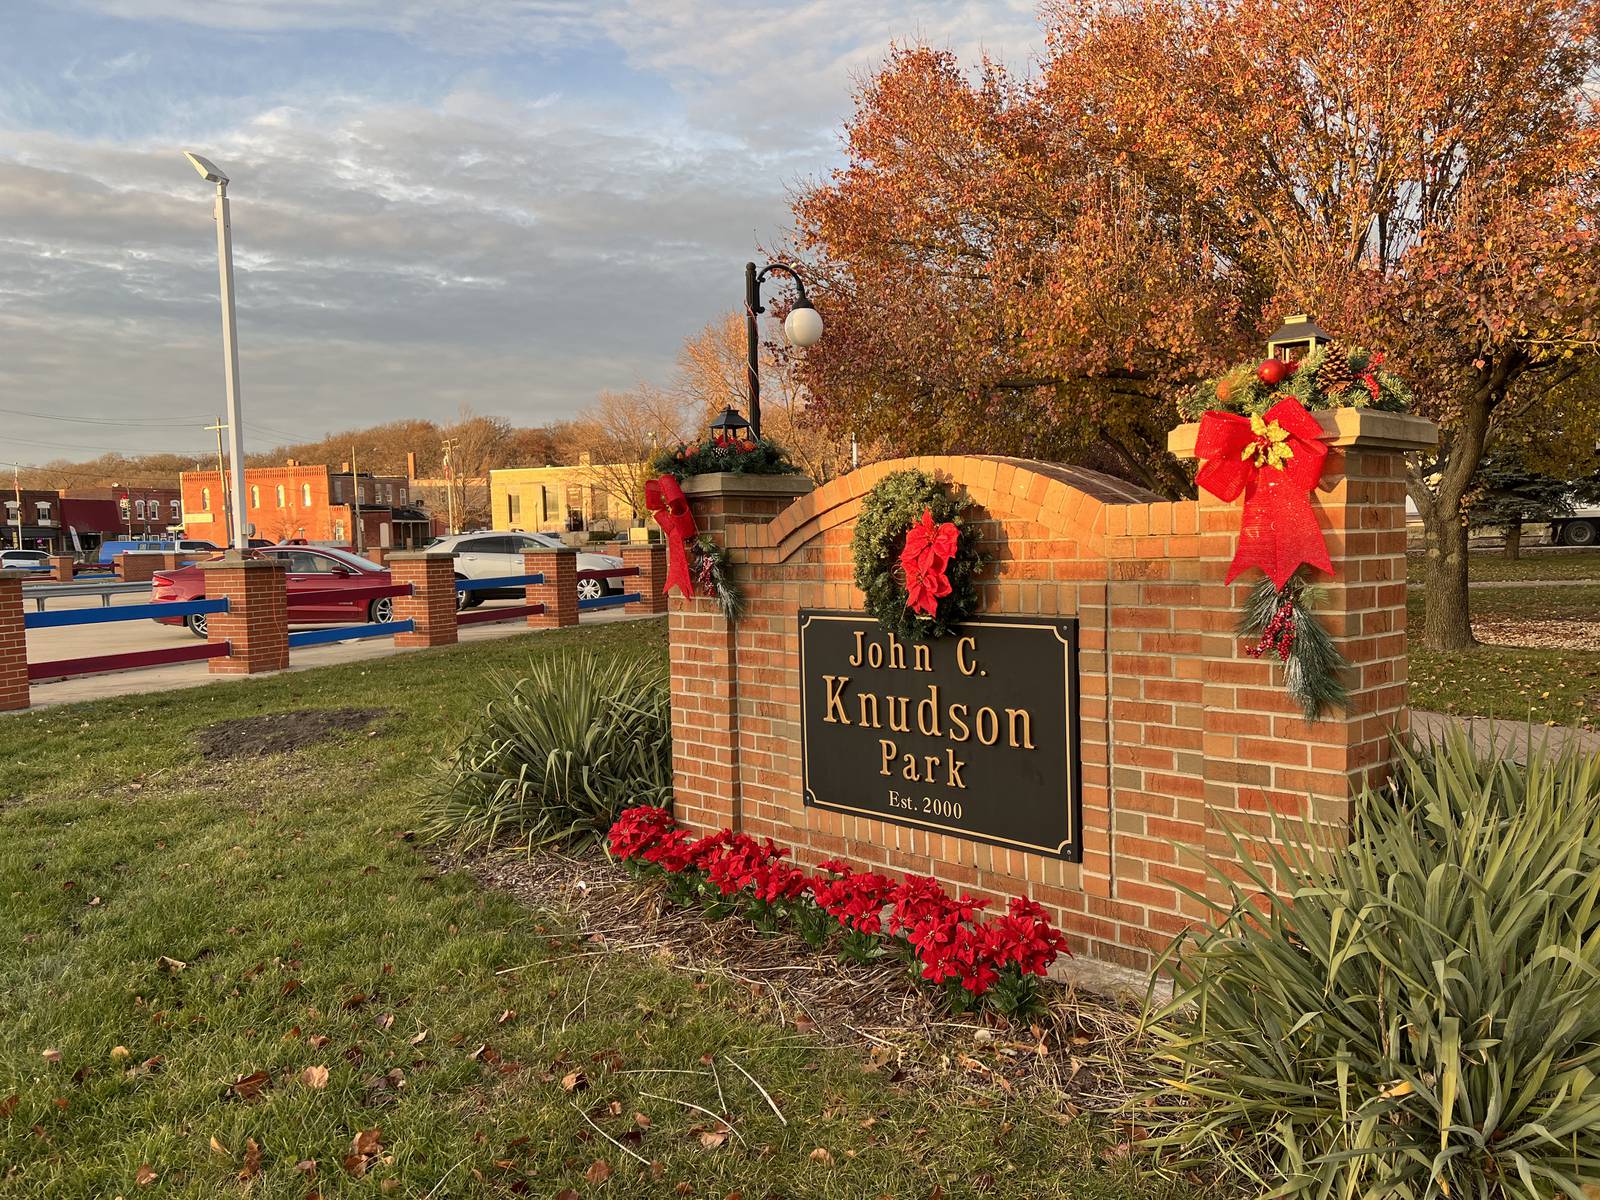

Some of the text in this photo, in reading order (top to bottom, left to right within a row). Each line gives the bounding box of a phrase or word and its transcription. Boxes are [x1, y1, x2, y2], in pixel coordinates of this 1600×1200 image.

[849, 631, 987, 676] John C.
[822, 674, 1035, 750] Knudson
[879, 739, 967, 789] Park
[888, 790, 963, 819] Est. 2000
